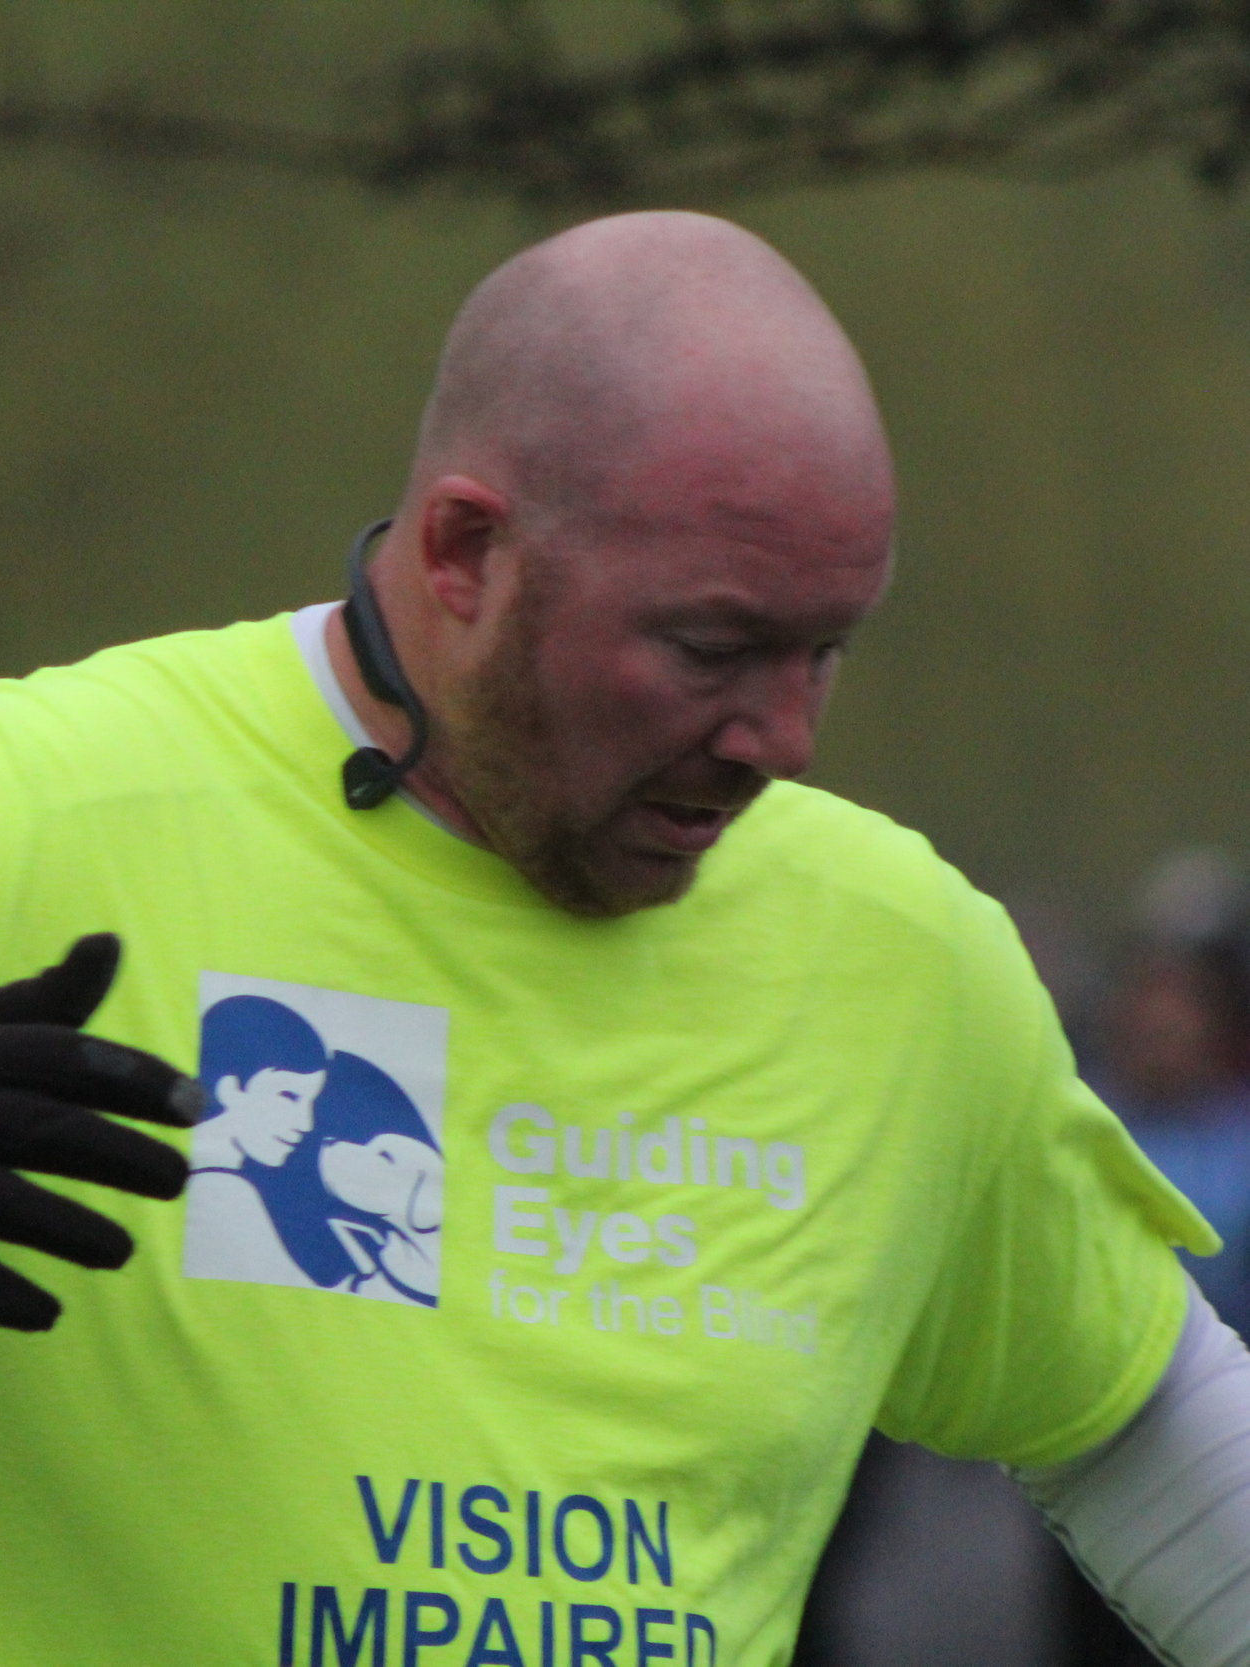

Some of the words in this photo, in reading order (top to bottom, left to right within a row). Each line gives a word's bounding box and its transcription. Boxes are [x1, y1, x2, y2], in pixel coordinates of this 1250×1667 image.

[488, 1102, 805, 1211] Guiding
[493, 1185, 697, 1275] Eyes
[488, 1268, 570, 1327] for
[589, 1280, 684, 1336] the
[701, 1284, 818, 1355] Blind
[356, 1475, 672, 1587] VISION
